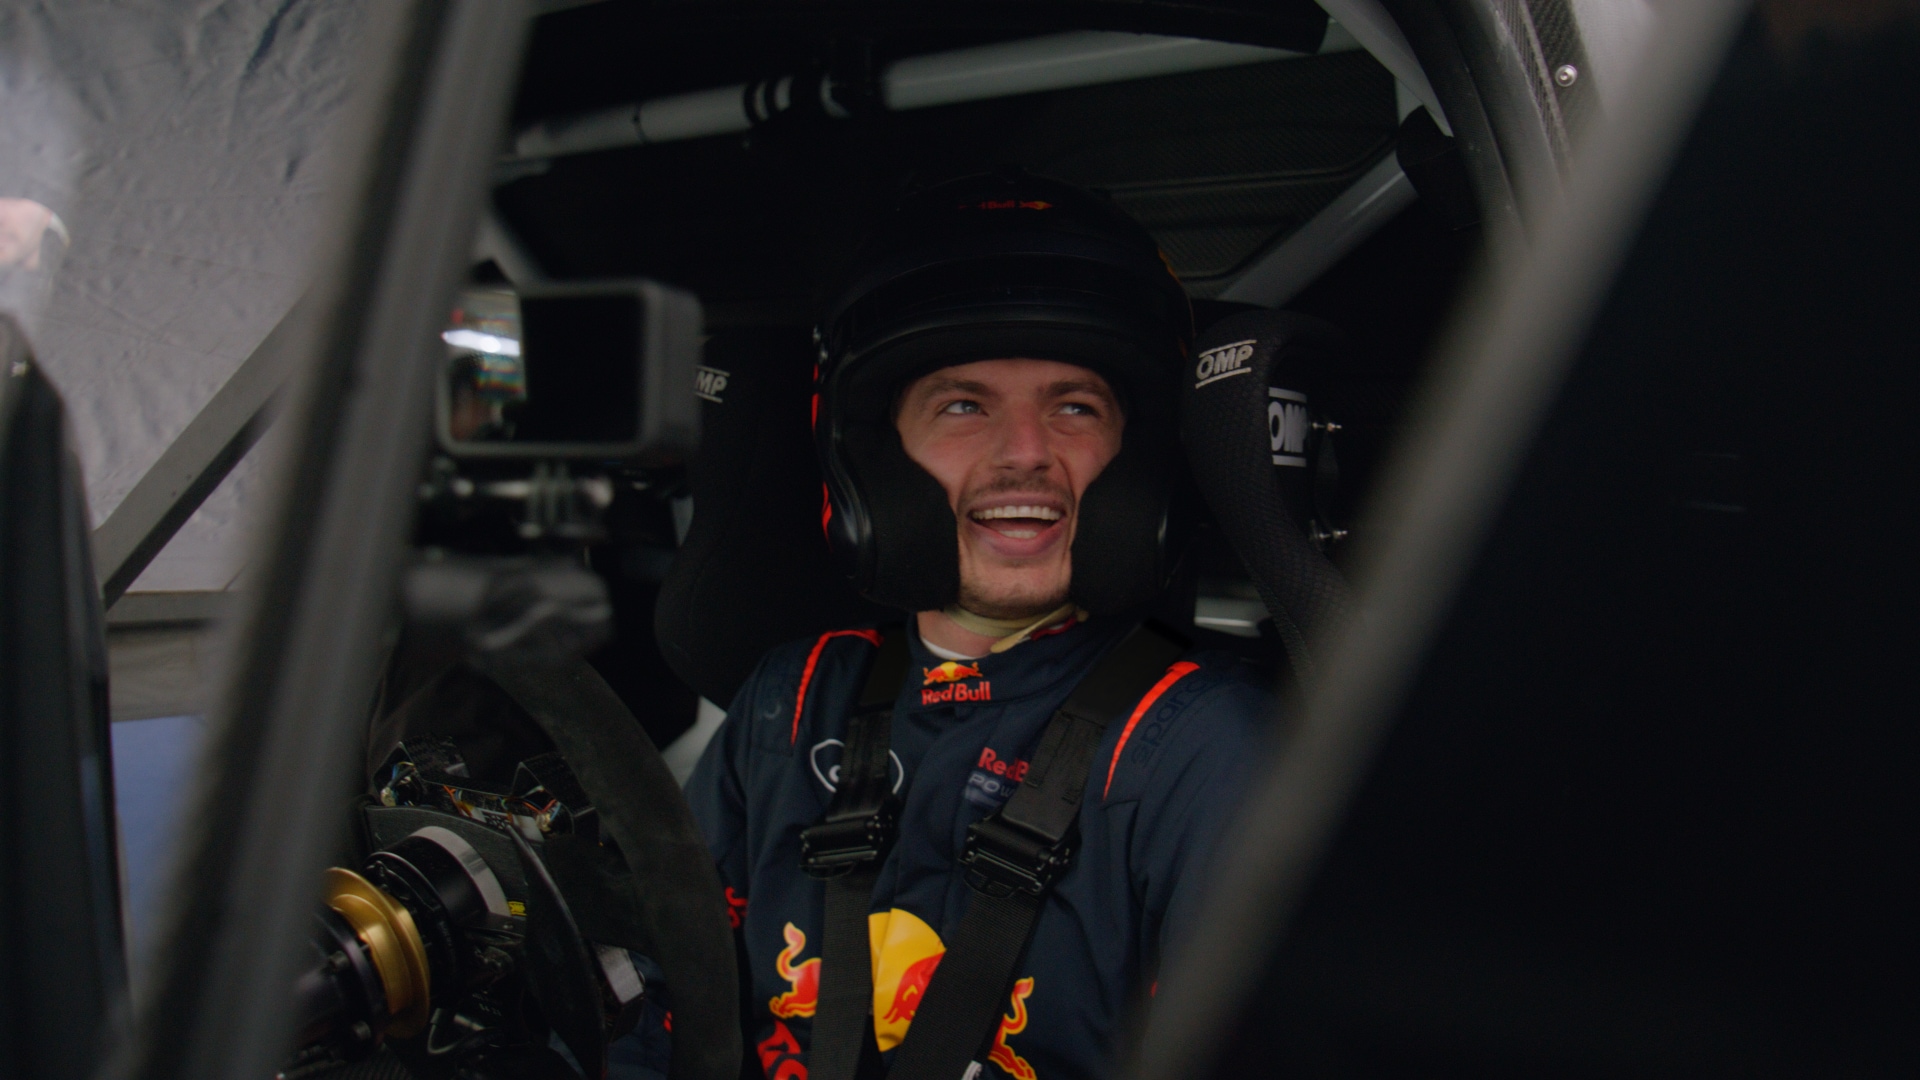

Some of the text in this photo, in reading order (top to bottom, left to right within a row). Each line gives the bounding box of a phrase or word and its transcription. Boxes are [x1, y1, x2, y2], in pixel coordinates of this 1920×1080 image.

[1195, 345, 1254, 380] OMP
[697, 371, 728, 396] MP
[1267, 400, 1308, 453] OMP
[921, 681, 991, 706] Red Bull
[1131, 674, 1218, 767] sparc
